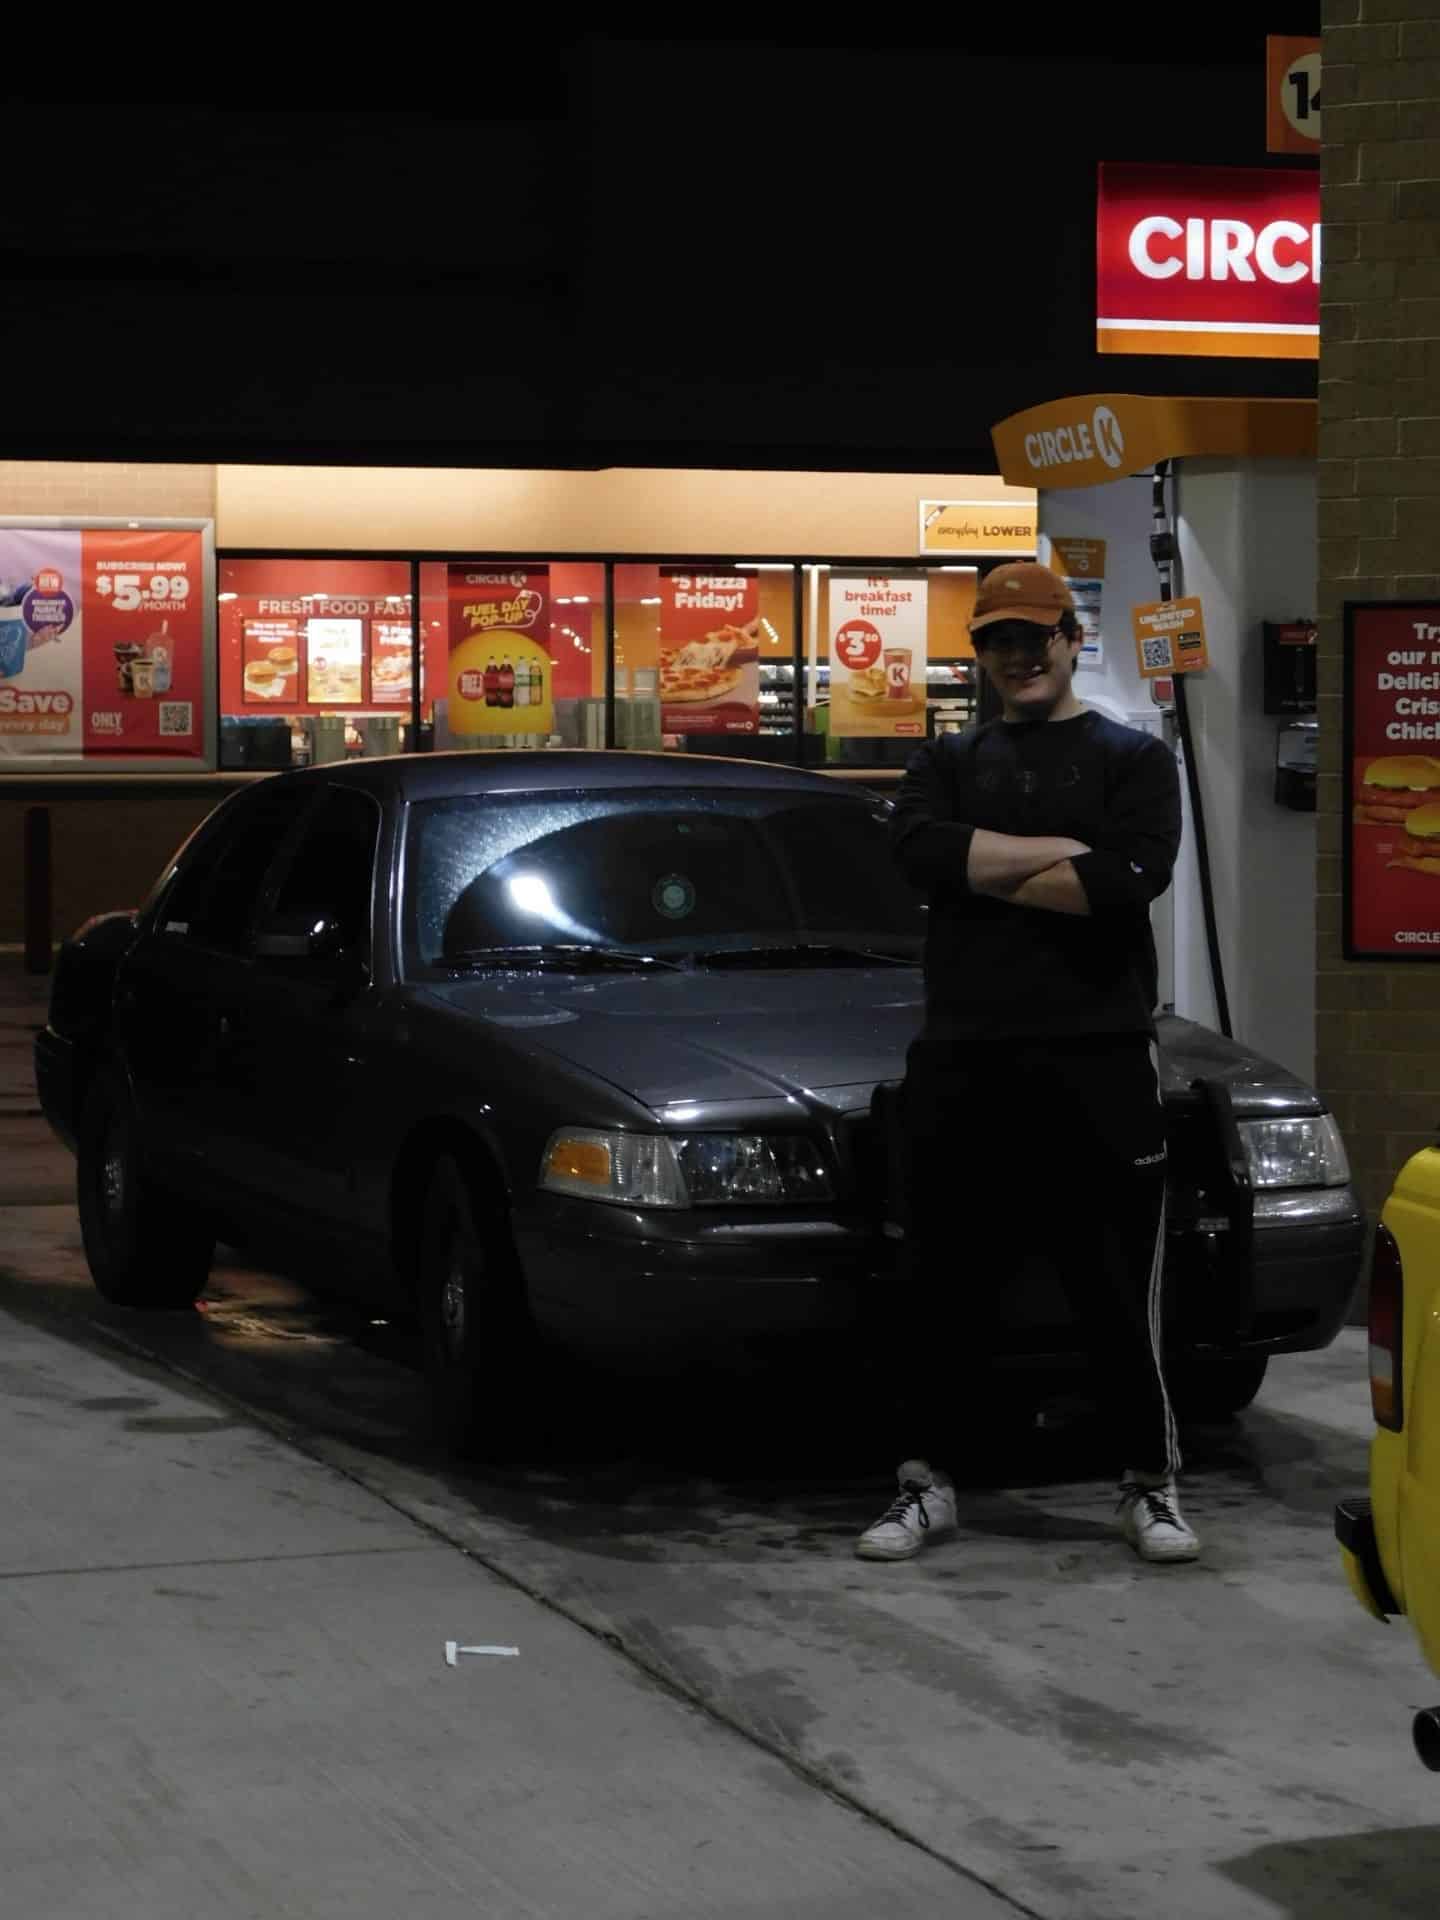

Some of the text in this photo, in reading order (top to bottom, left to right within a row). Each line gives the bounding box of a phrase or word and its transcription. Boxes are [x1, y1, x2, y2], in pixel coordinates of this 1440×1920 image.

[1024, 405, 1124, 469] CIRCLE K
[983, 526, 1031, 537] LOWER
[466, 574, 508, 585] CIRCLE
[695, 576, 748, 590] Pizza
[96, 575, 190, 611] $5.99
[675, 591, 744, 612] Friday!
[845, 590, 912, 602] breakfast
[258, 600, 313, 614] FRESH
[319, 601, 369, 614] FOOD
[463, 599, 530, 618] FUEL DAY
[860, 605, 897, 616] time!
[470, 610, 525, 628] POP-UP
[1386, 650, 1426, 665] our
[1377, 671, 1440, 690] Delici
[0, 689, 70, 713] Save
[1394, 697, 1440, 716] Cris
[92, 711, 122, 729] ONLY
[1394, 930, 1440, 944] CIRCLE
